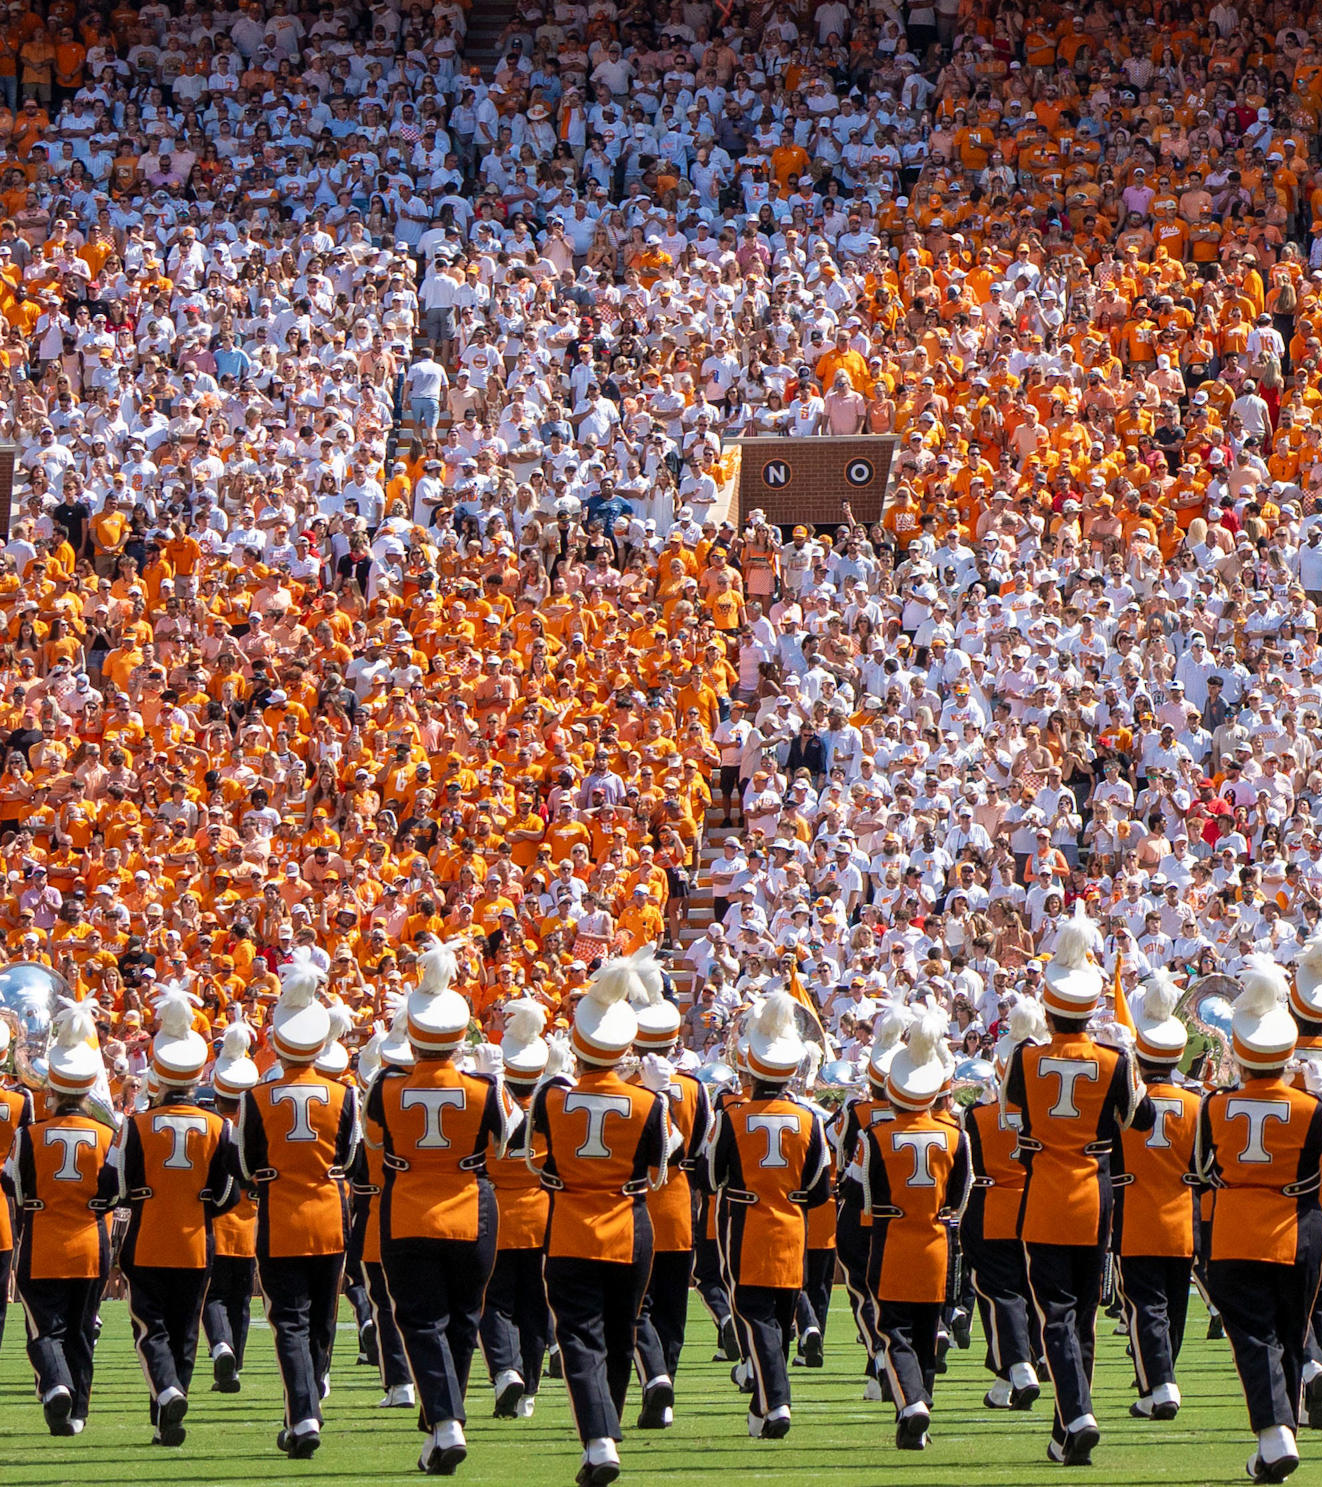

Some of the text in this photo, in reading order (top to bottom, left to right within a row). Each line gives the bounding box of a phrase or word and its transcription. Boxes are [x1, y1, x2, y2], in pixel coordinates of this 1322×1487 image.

[753, 186, 764, 196] T
[1051, 173, 1062, 189] T
[159, 213, 168, 226] T
[1060, 253, 1073, 268] T
[132, 475, 143, 491] 2
[768, 465, 785, 484] N
[850, 464, 869, 482] O
[396, 768, 406, 792] 6
[924, 860, 935, 872] T
[1038, 1057, 1099, 1118] T
[270, 1085, 330, 1142] T
[402, 1088, 467, 1149] T
[563, 1091, 632, 1158] T
[1145, 1098, 1184, 1149] T
[1225, 1098, 1291, 1164] T
[44, 1128, 97, 1182] T
[152, 1114, 208, 1169] T
[746, 1114, 801, 1168] T
[892, 1131, 948, 1188] T
